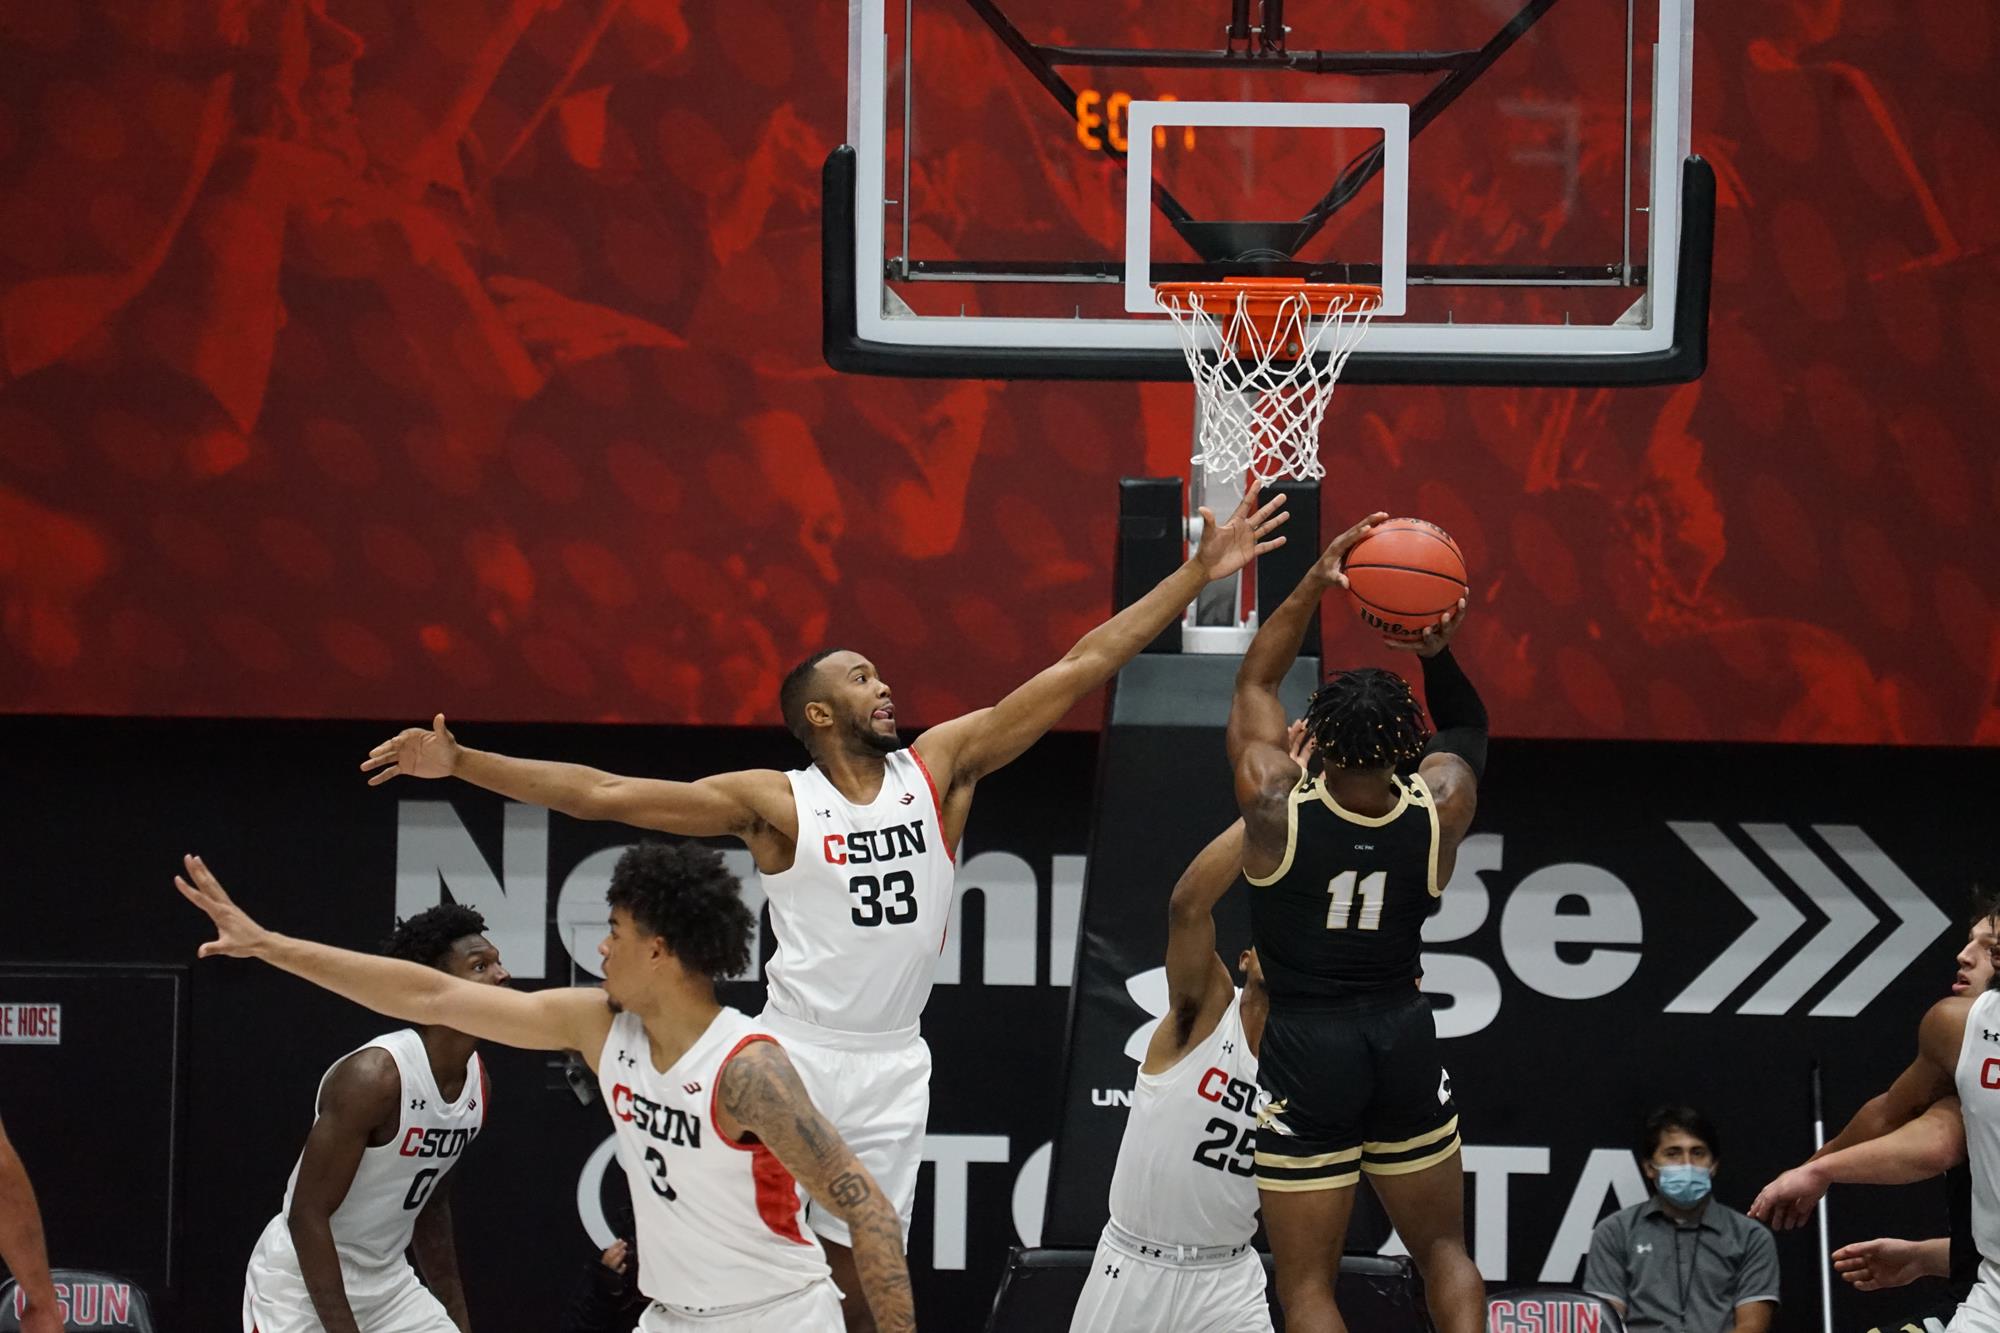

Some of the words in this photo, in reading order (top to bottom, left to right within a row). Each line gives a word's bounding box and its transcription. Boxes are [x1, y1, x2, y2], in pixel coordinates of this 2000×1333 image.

[823, 819, 927, 865] CSUN
[849, 870, 918, 927] 33
[1326, 870, 1388, 931] 11
[18, 1007, 58, 1037] HOSE
[612, 1083, 701, 1149] CSUN
[645, 1146, 677, 1202] 3
[1192, 1117, 1256, 1177] 25
[403, 1168, 439, 1210] 0
[1488, 1300, 1601, 1333] CSUN
